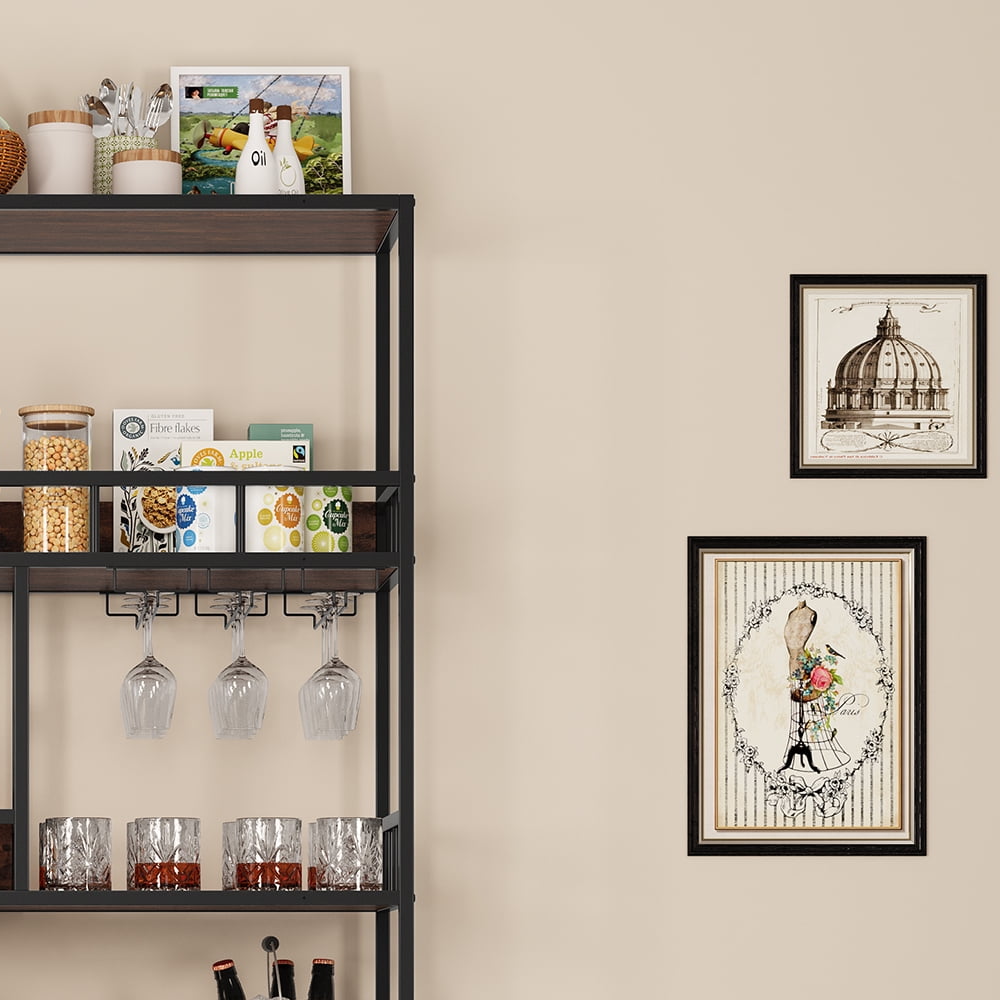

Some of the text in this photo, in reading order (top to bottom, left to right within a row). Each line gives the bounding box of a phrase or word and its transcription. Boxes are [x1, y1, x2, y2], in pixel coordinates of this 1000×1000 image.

[251, 150, 267, 166] Oil
[122, 429, 145, 439] ORGANIC
[150, 422, 200, 433] Fibre flakes
[229, 448, 263, 461] Apple
[827, 693, 869, 716] Paris
